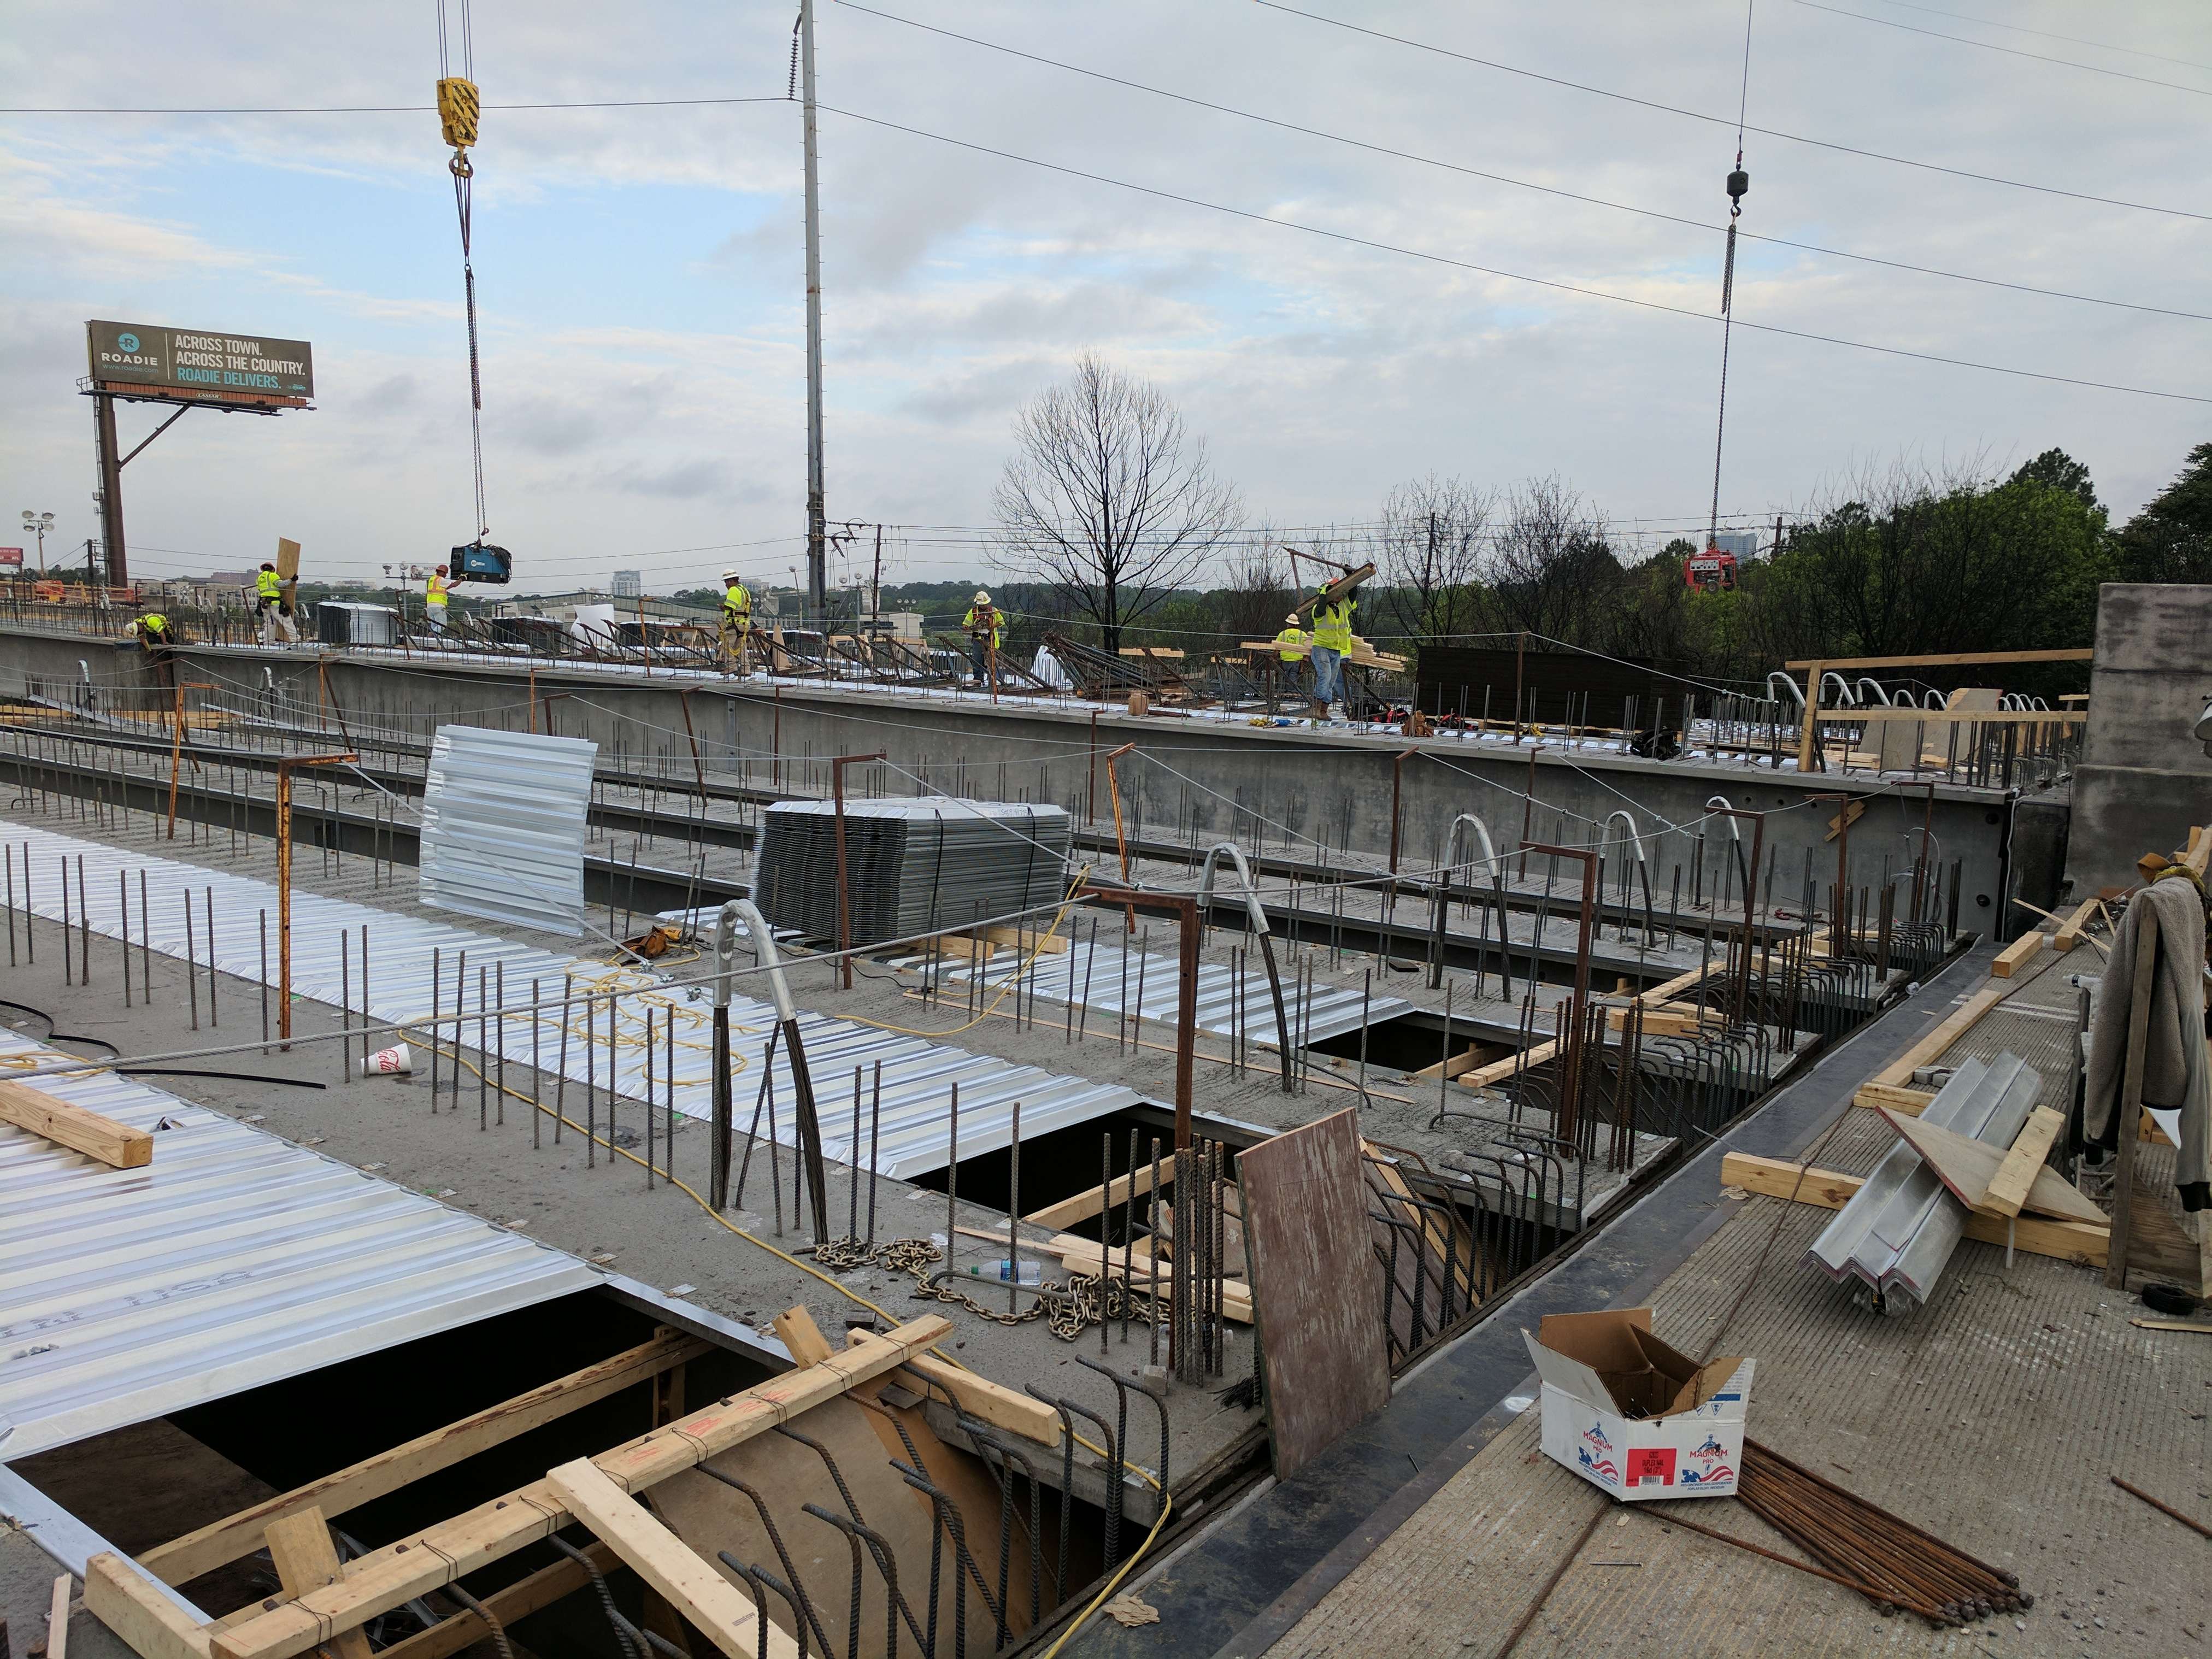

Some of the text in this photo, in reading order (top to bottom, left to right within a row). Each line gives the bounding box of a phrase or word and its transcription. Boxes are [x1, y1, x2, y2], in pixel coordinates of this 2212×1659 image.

[175, 334, 262, 356] ACROSS TOWN.
[101, 352, 158, 366] ROADIE
[102, 364, 158, 374] www.roadie.com
[176, 351, 305, 375] ACROSS THE COUNTRY.
[177, 367, 281, 389] ROADIE DELIVERS.
[378, 1049, 401, 1072] Cola
[1583, 1431, 1613, 1452] MAGNUM
[1593, 1445, 1602, 1454] PRO
[1689, 1449, 1728, 1458] MAGNUM
